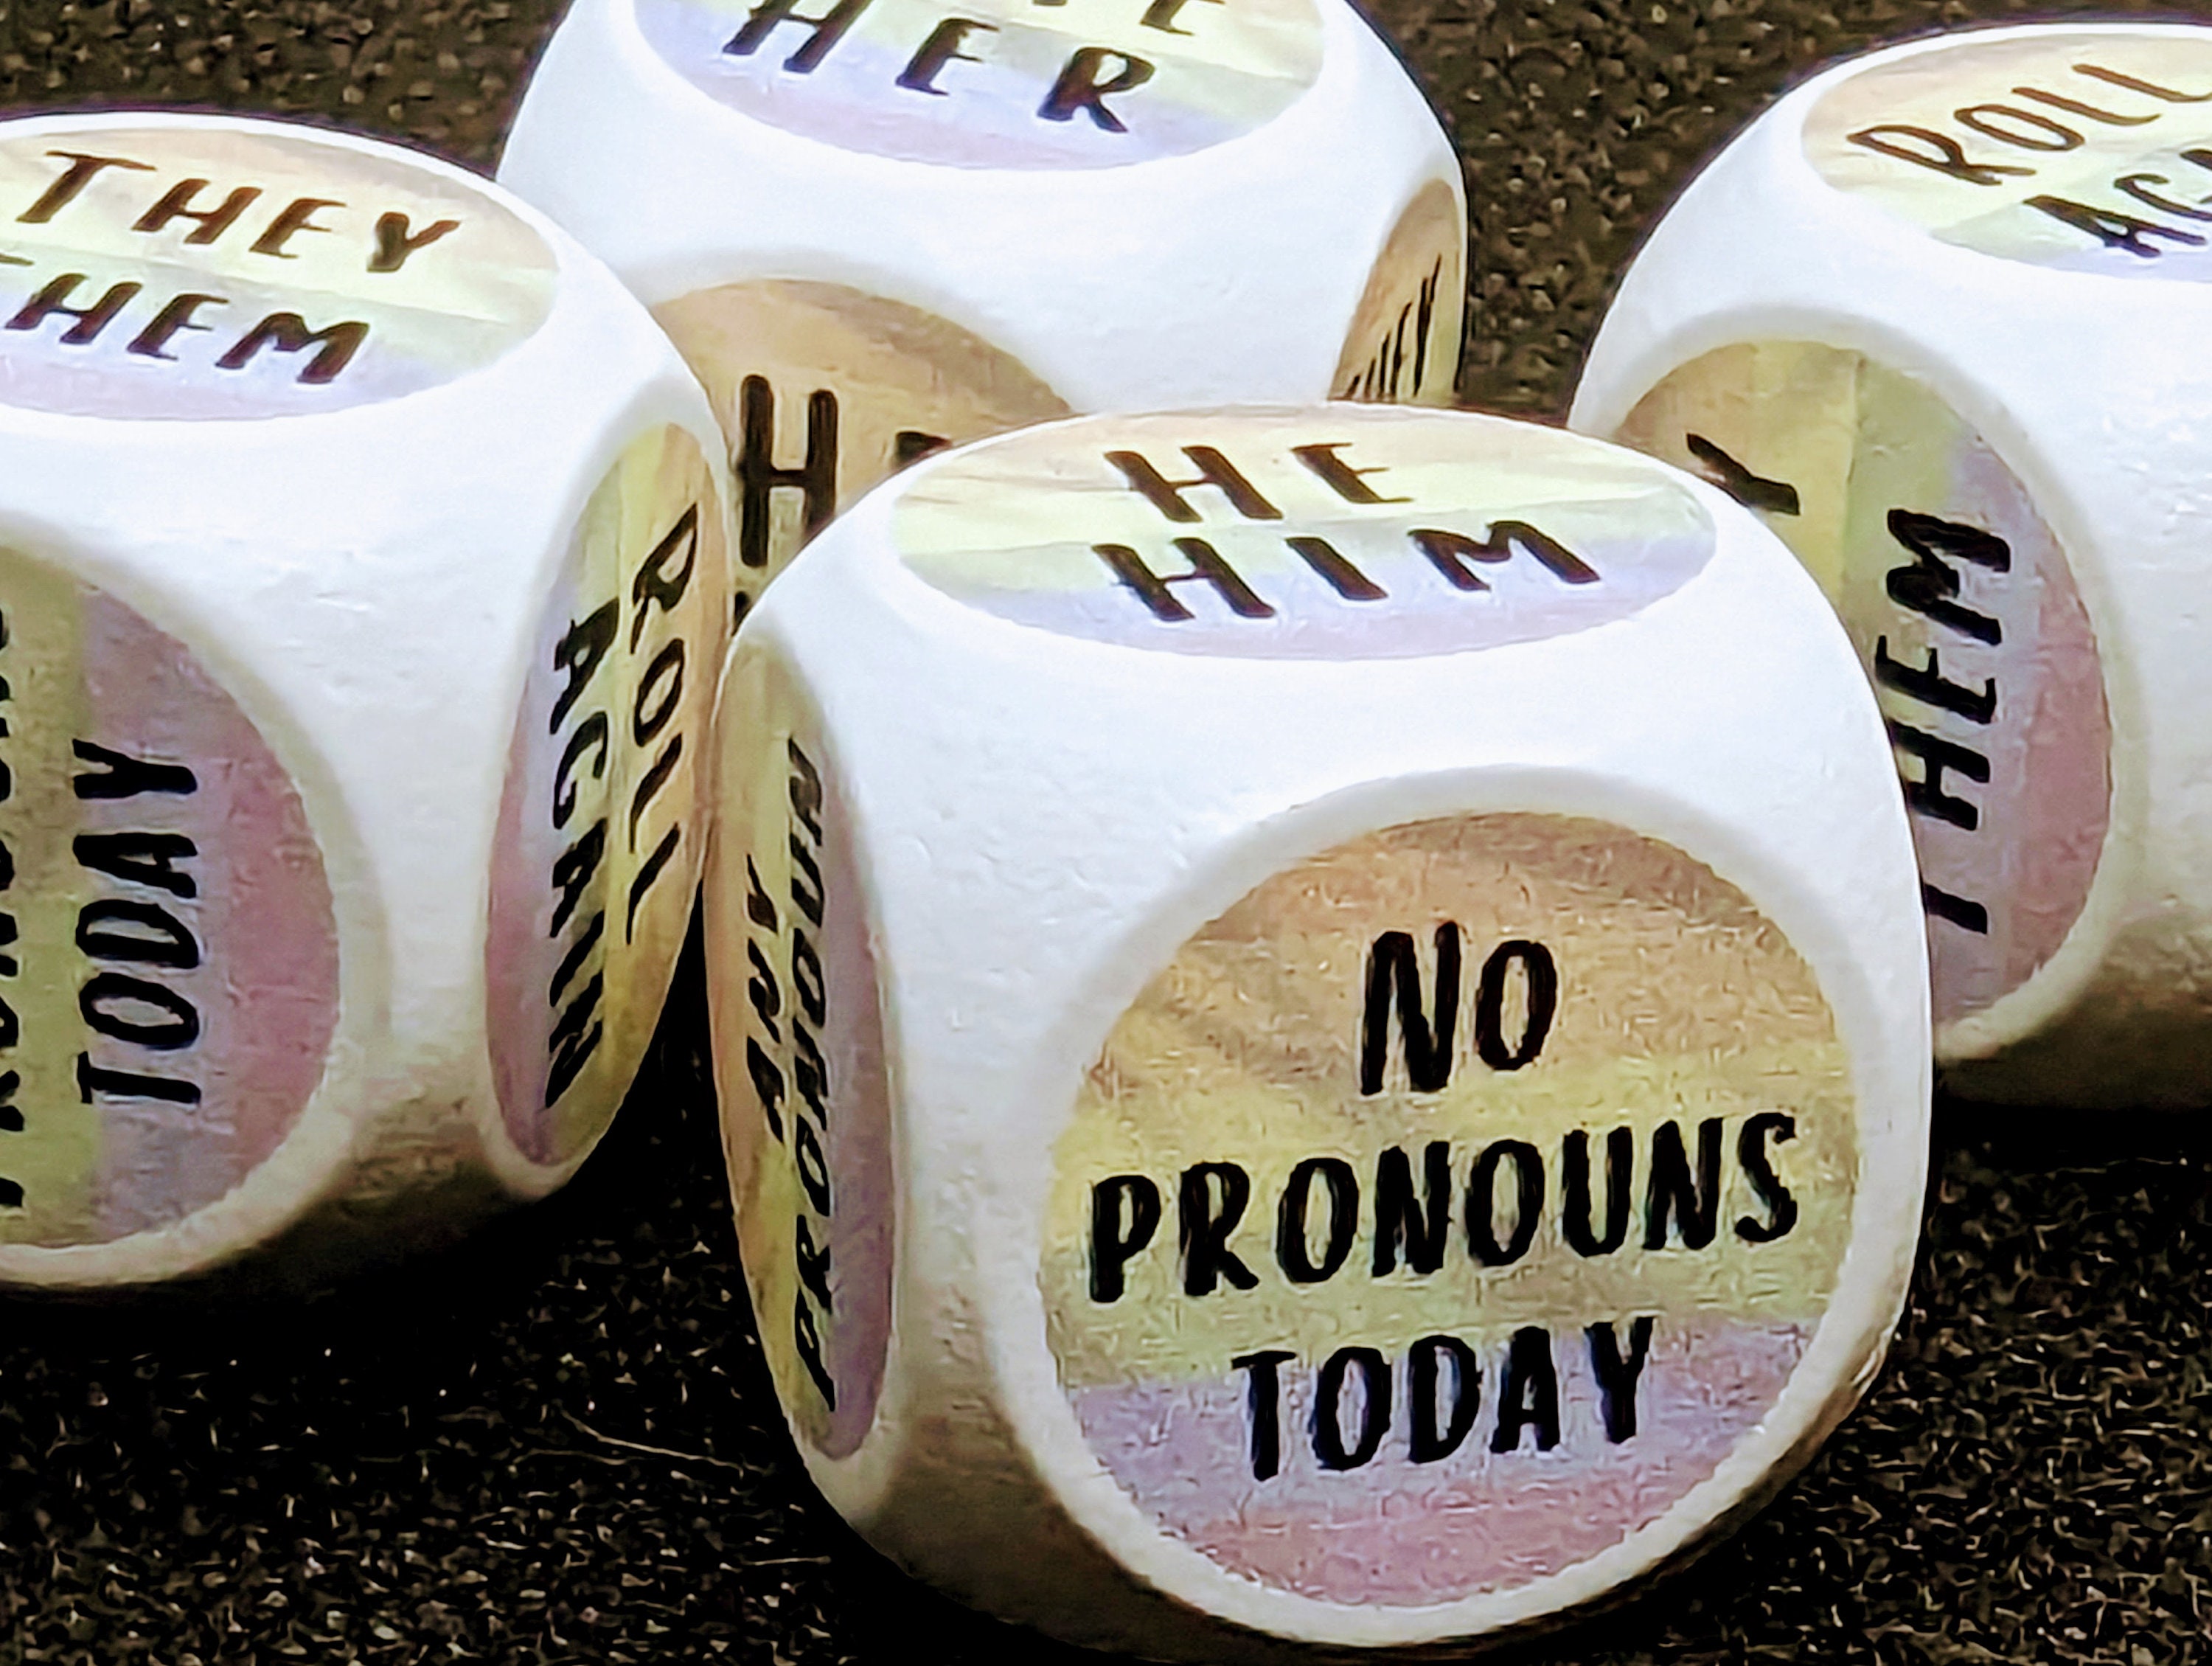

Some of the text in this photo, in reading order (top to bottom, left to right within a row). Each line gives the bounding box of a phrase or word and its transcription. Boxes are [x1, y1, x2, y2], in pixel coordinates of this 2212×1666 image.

[723, 0, 1155, 133] HER
[1846, 64, 2212, 186] ROLL
[16, 151, 462, 273] THEY
[0, 253, 369, 384] HEM
[1103, 442, 1414, 522] HE
[1092, 520, 1601, 622] HIM
[627, 502, 698, 947] ROLL
[72, 738, 201, 1105] TODAY
[544, 597, 619, 1109] AGAIN
[1361, 920, 1558, 1096] NO
[1089, 1112, 1799, 1303] PRONOUNS
[1232, 1315, 1657, 1482] TODAY
